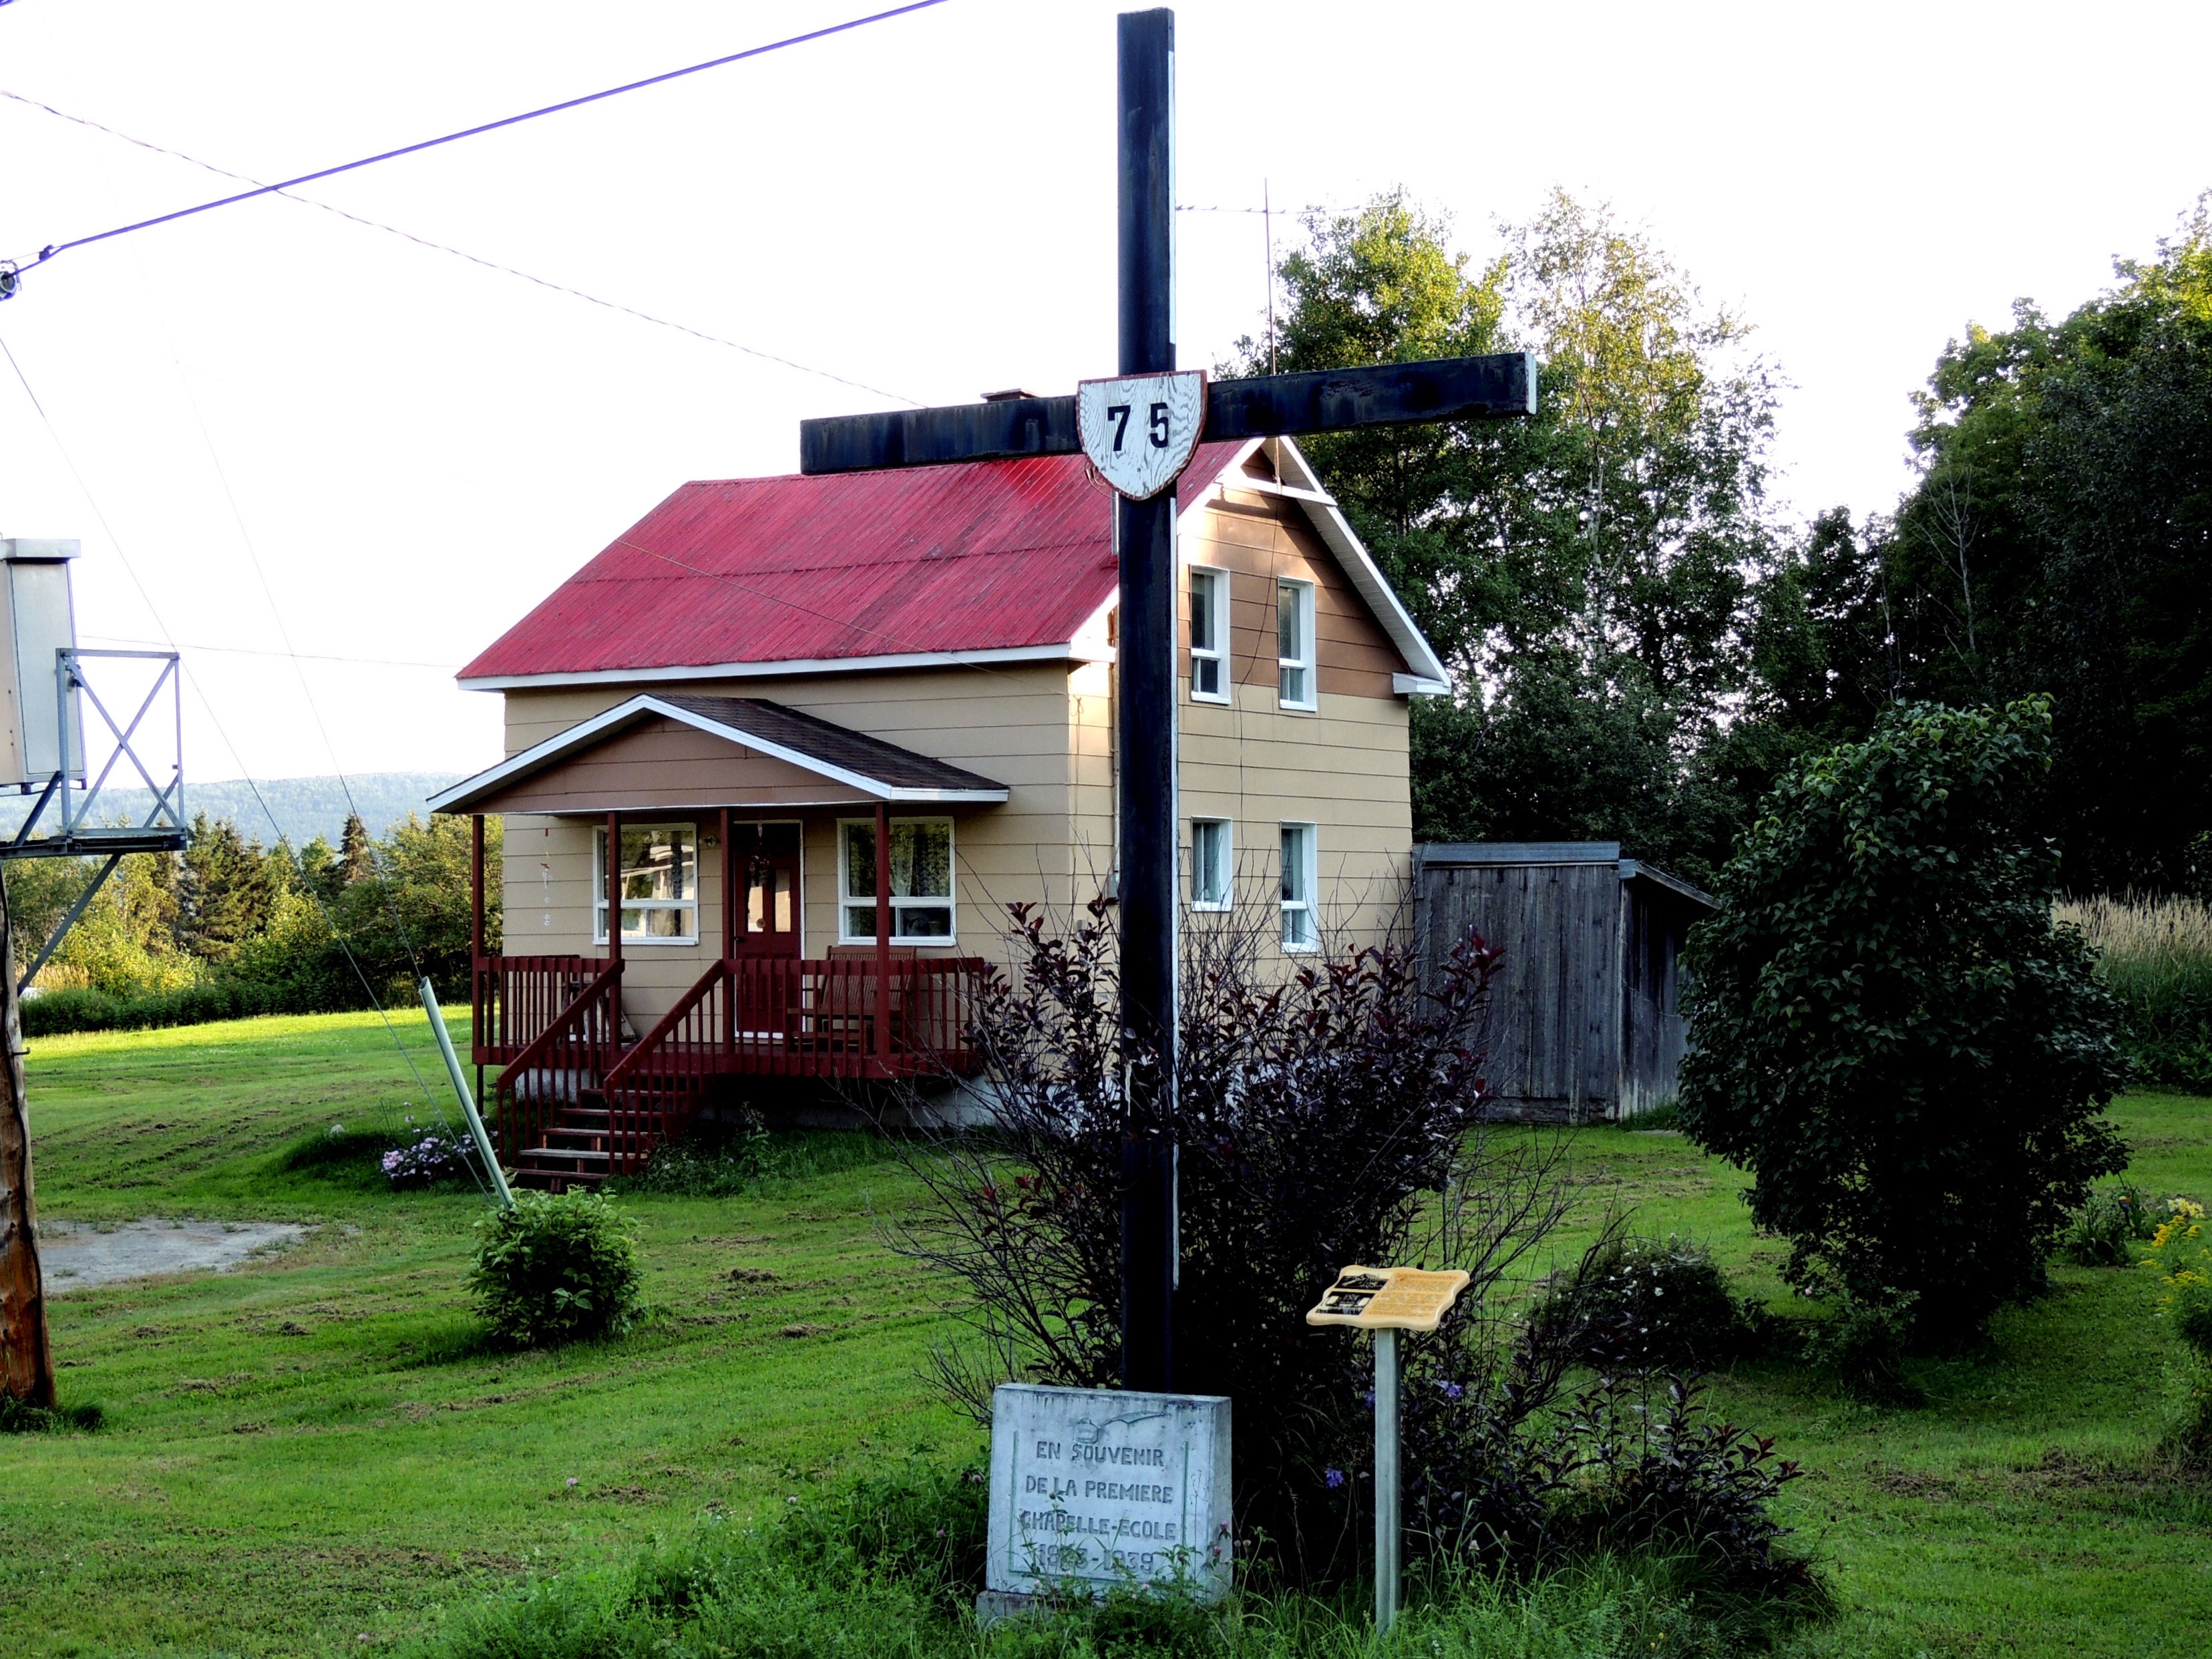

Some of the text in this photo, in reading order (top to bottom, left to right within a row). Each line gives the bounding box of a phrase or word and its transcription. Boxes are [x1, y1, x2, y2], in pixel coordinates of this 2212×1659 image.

[1107, 402, 1169, 451] 75
[1036, 1441, 1165, 1467] EN SOUVENIR
[1026, 1475, 1173, 1503] DE LA PREMIERE
